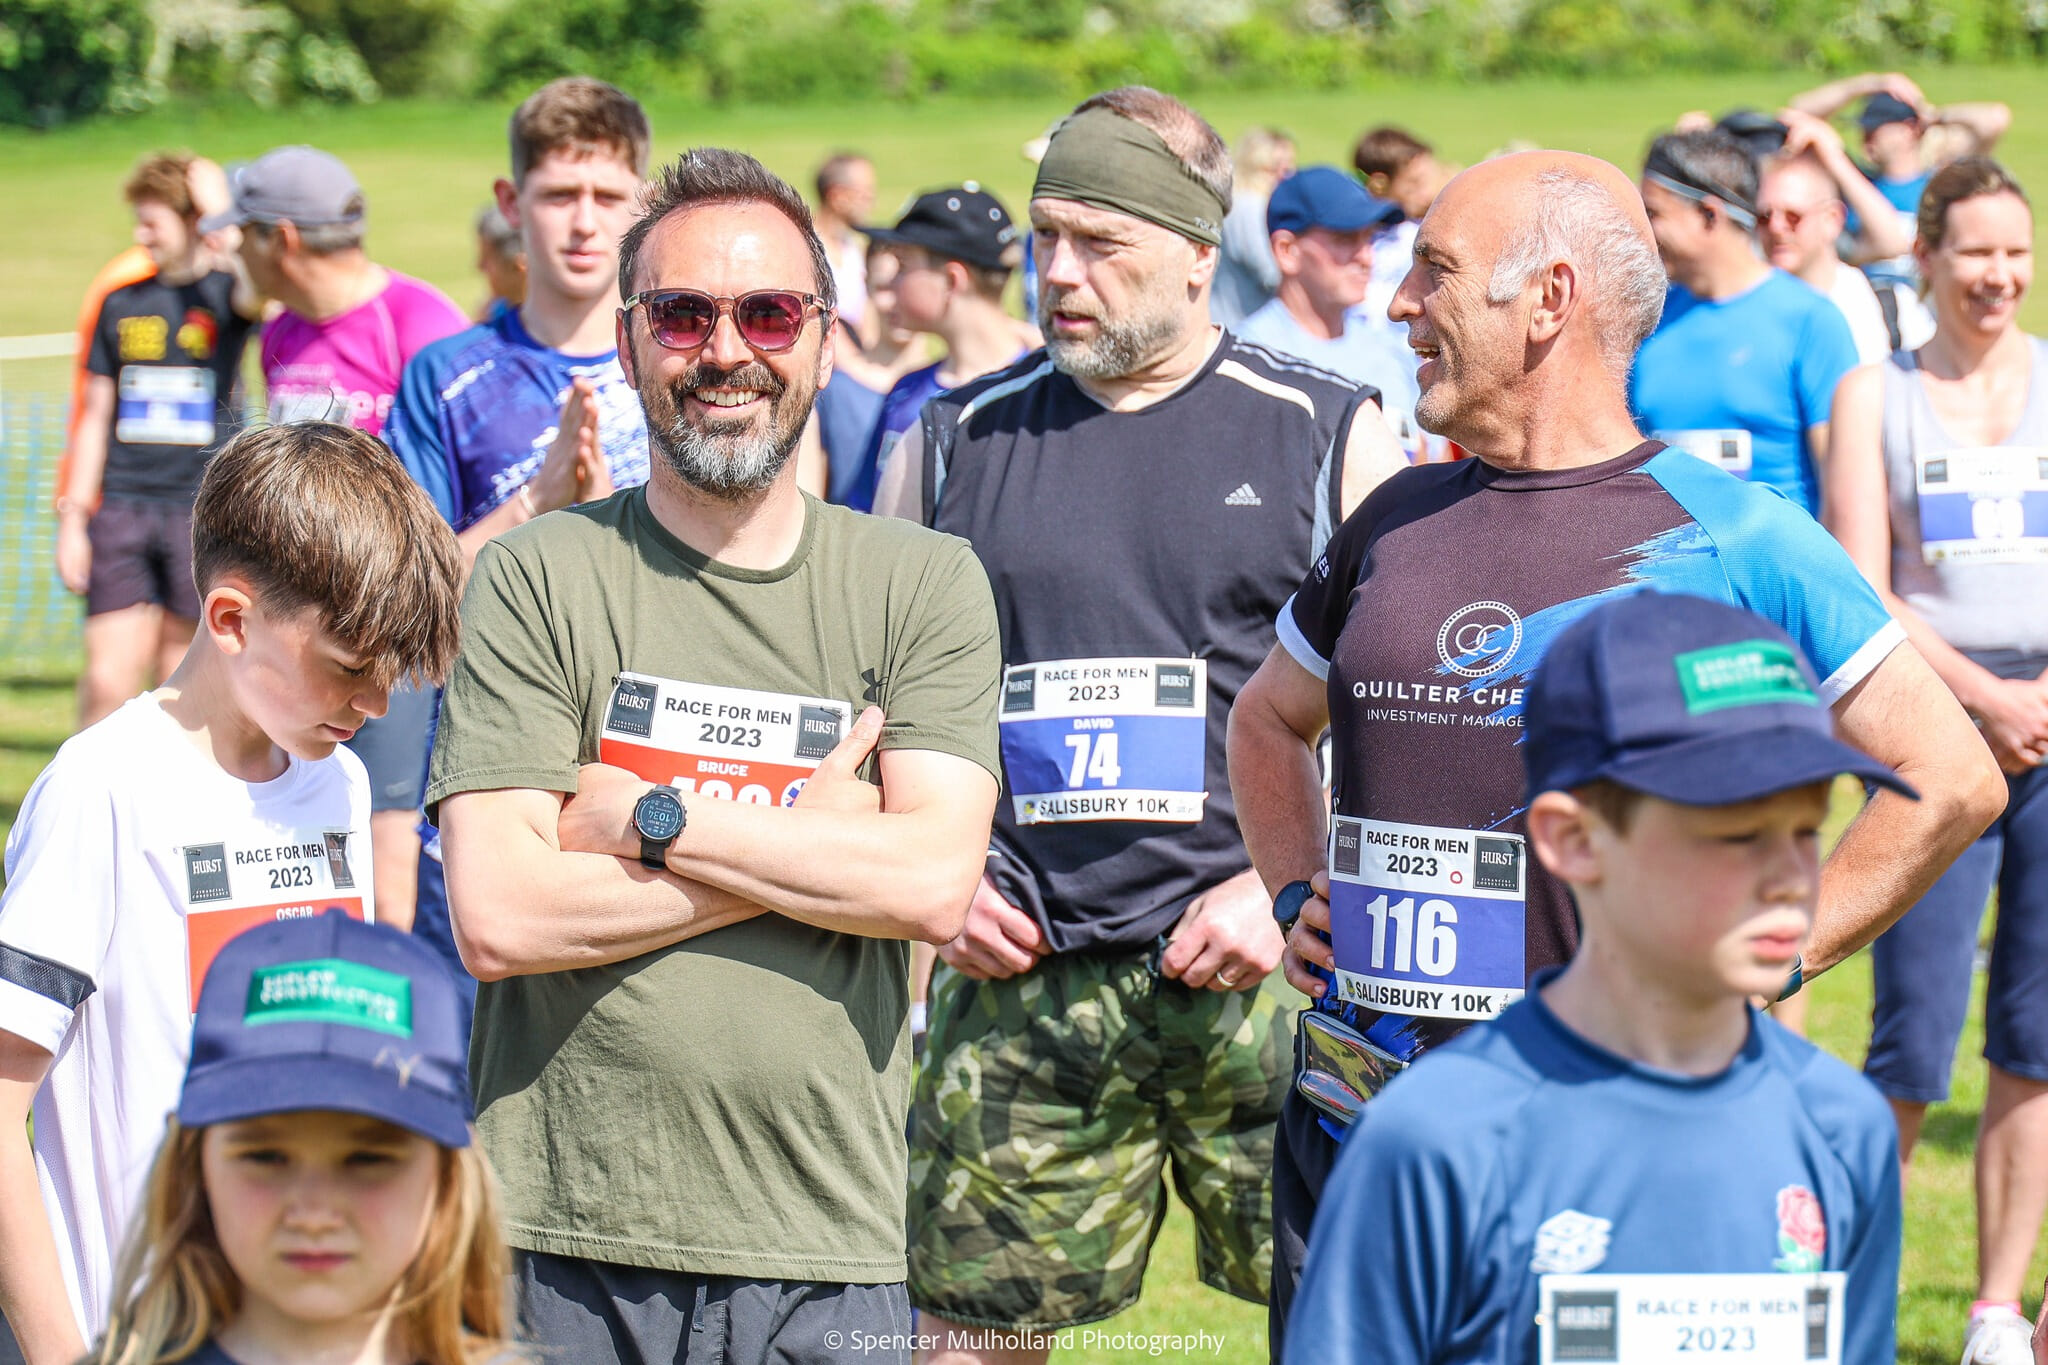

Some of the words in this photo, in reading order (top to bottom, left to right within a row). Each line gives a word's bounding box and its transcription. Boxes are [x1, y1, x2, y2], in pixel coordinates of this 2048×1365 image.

[1043, 669, 1078, 682] RACE
[1084, 668, 1111, 679] FOR
[1117, 668, 1148, 679] MEN
[1159, 674, 1192, 688] HURST
[618, 692, 651, 710] HURST
[1068, 685, 1120, 701] 2023
[1353, 681, 1460, 704] QUILTER
[665, 697, 713, 716] RACE
[719, 705, 750, 721] FOR
[757, 711, 792, 726] MEN
[1367, 709, 1458, 725] INVESTMENT
[804, 719, 837, 735] HURST
[1073, 718, 1114, 730] DAVID
[699, 723, 762, 748] 2023
[697, 760, 749, 777] BRUCE
[1065, 733, 1121, 788] 74
[1039, 797, 1128, 816] SALISBURY
[1137, 799, 1169, 813] 10K
[1338, 835, 1358, 849] HURST
[1366, 830, 1398, 847] RACE
[1402, 835, 1430, 851] FOR
[1435, 839, 1469, 854] MEN
[235, 847, 272, 865] RACE
[276, 846, 300, 860] FOR
[302, 842, 325, 858] MEN
[1481, 850, 1514, 866] HURST
[192, 858, 222, 875] HURST
[1386, 853, 1438, 877] 2023
[268, 865, 313, 889] 2023
[276, 905, 314, 920] OSCAR
[1366, 894, 1459, 977] 116
[1355, 980, 1443, 1010] SALISBURY
[1450, 993, 1492, 1013] 10K
[1636, 1299, 1698, 1315] RACE
[1711, 1299, 1750, 1315] FOR
[1760, 1299, 1799, 1314] MEN
[1557, 1305, 1613, 1330] HURST
[1676, 1327, 1756, 1351] 2023
